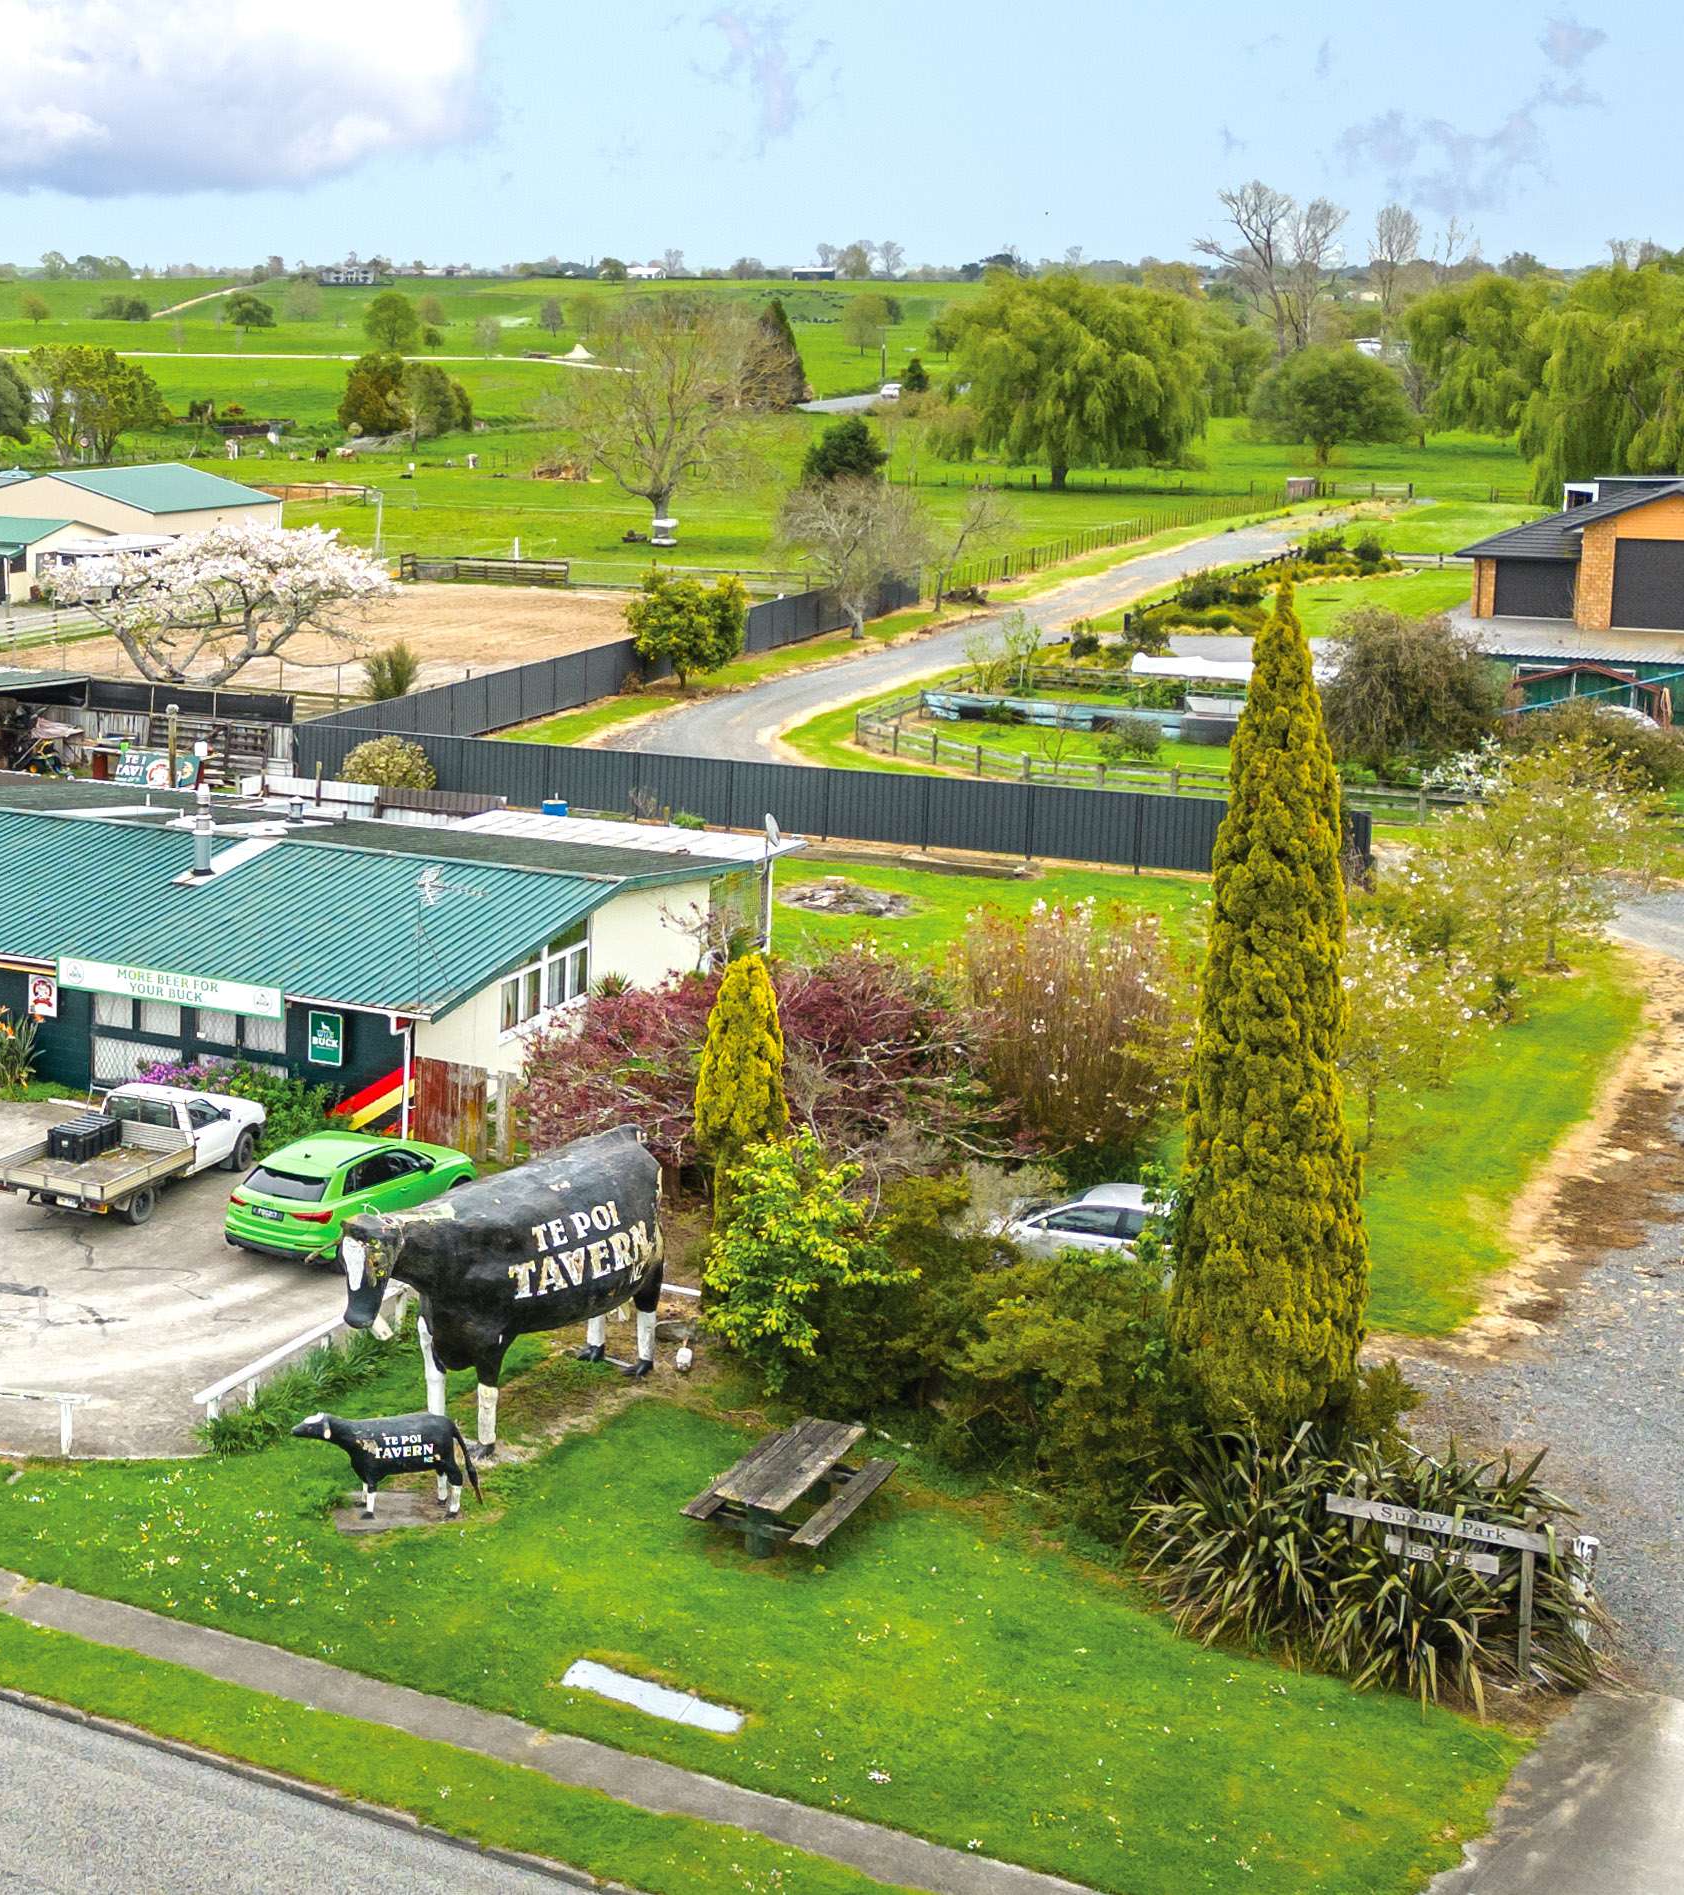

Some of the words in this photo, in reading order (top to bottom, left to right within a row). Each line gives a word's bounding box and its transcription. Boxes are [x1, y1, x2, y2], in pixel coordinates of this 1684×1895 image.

[116, 967, 153, 983] MORE
[156, 973, 189, 988] BEER
[193, 979, 219, 993] FOR
[129, 982, 170, 997] YOUR
[168, 987, 203, 1003] BUCK
[312, 1036, 339, 1048] BUCK
[532, 1218, 568, 1252] TE
[569, 1200, 621, 1239] POI
[508, 1220, 654, 1300] TAVERN
[383, 1436, 398, 1445] TE
[401, 1434, 422, 1444] POI
[375, 1443, 434, 1459] TAVERN
[1461, 1522, 1507, 1541] Park
